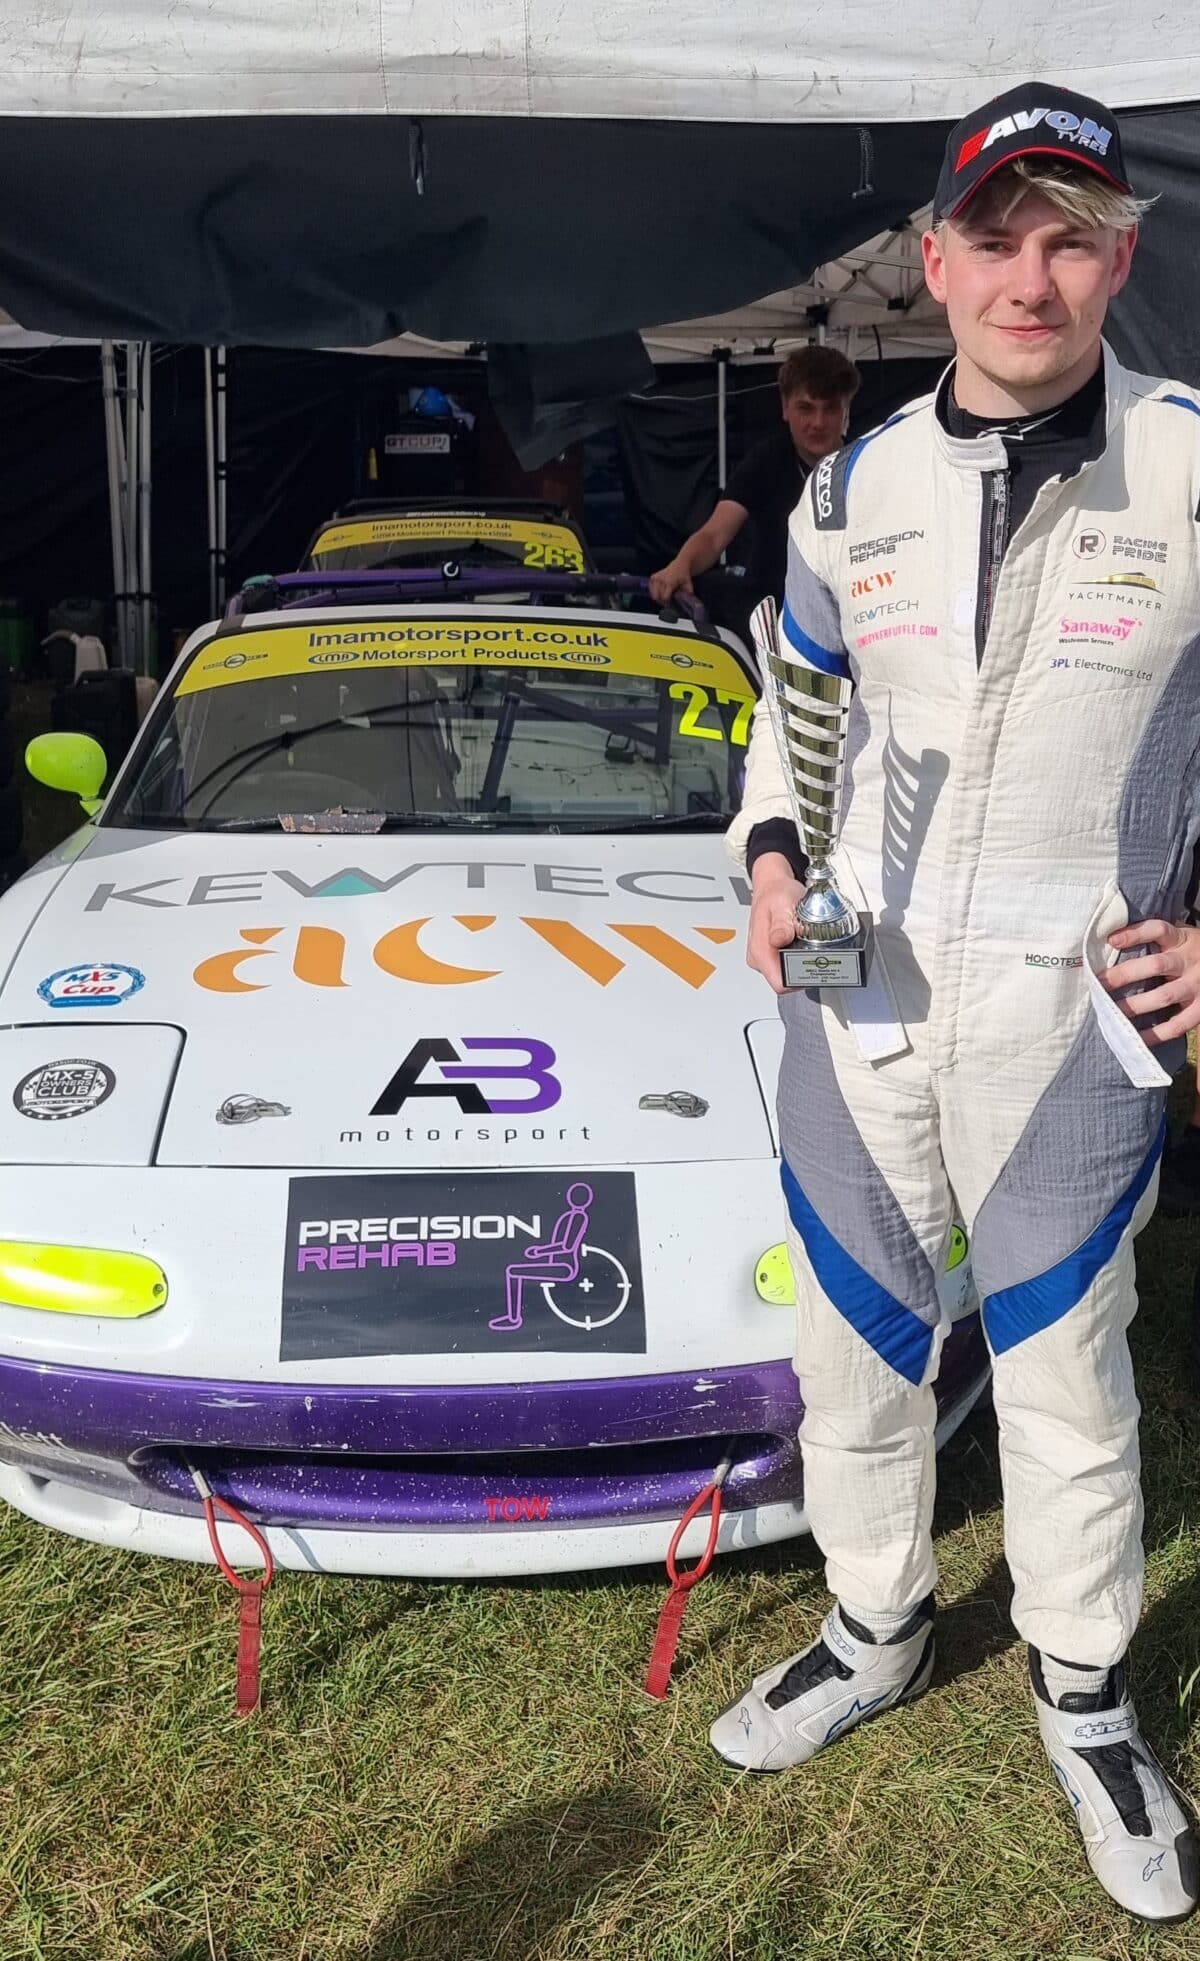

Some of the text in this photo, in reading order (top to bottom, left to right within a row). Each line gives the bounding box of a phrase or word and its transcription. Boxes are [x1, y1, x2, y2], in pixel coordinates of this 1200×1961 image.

[981, 107, 1113, 151] AVON
[1057, 129, 1108, 156] TYRES
[849, 530, 925, 555] PRECISION
[1112, 545, 1168, 563] PRIDE
[1113, 535, 1168, 551] RACING
[524, 541, 584, 574] 263
[850, 545, 896, 566] REHAB
[853, 599, 919, 625] KEWTECH
[1069, 591, 1162, 611] YACHTMAYER
[1060, 618, 1131, 640] Sanaway
[362, 648, 467, 661] Motorsport
[474, 648, 558, 661] Products
[1050, 658, 1153, 681] 3PL Electronics Ltd
[668, 682, 757, 747] 27
[193, 915, 737, 993] acw
[63, 984, 115, 995] Cup
[40, 1079, 92, 1088] OWNERS
[43, 1070, 96, 1081] MX-5
[368, 1037, 562, 1116] AB
[38, 1086, 90, 1097] CLUB
[340, 1125, 591, 1143] motorsport
[298, 1214, 541, 1246] PRECISION
[297, 1241, 457, 1272] REHAB
[484, 1496, 551, 1521] TOW
